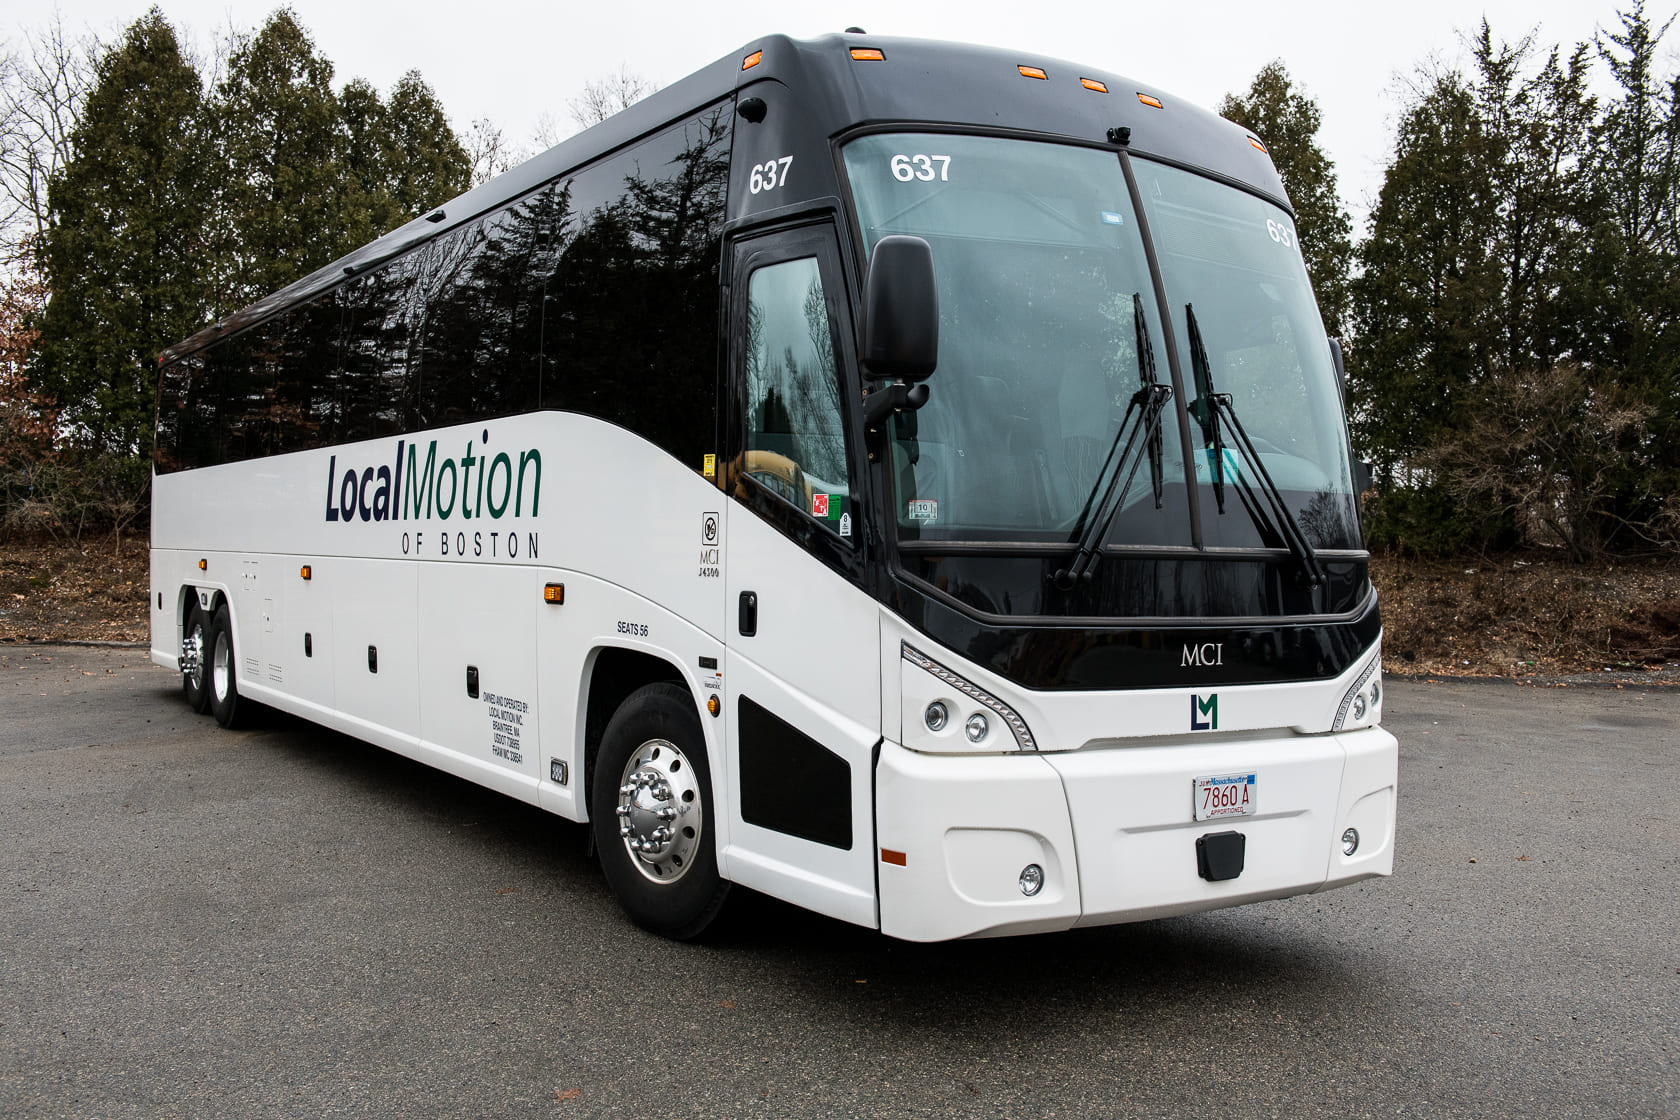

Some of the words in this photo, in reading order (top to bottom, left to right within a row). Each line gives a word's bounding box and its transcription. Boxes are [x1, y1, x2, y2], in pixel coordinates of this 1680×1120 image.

[749, 155, 793, 194] 637
[890, 154, 951, 182] 637
[1266, 218, 1298, 252] 637
[325, 428, 542, 522] LocalMotion
[918, 503, 928, 511] 10
[402, 532, 423, 555] OF
[441, 532, 539, 558] BOSTON
[699, 548, 719, 565] MCI
[617, 620, 639, 636] SEATS
[640, 624, 648, 637] 56
[1180, 643, 1223, 667] MCI
[483, 691, 496, 705] OWNED
[504, 697, 522, 712] OPERATED
[488, 706, 500, 719] LOCAL
[501, 709, 515, 723] MOTION
[1203, 785, 1238, 809] 7860
[1242, 783, 1249, 805] A
[1210, 806, 1244, 815] APPORTIONED
